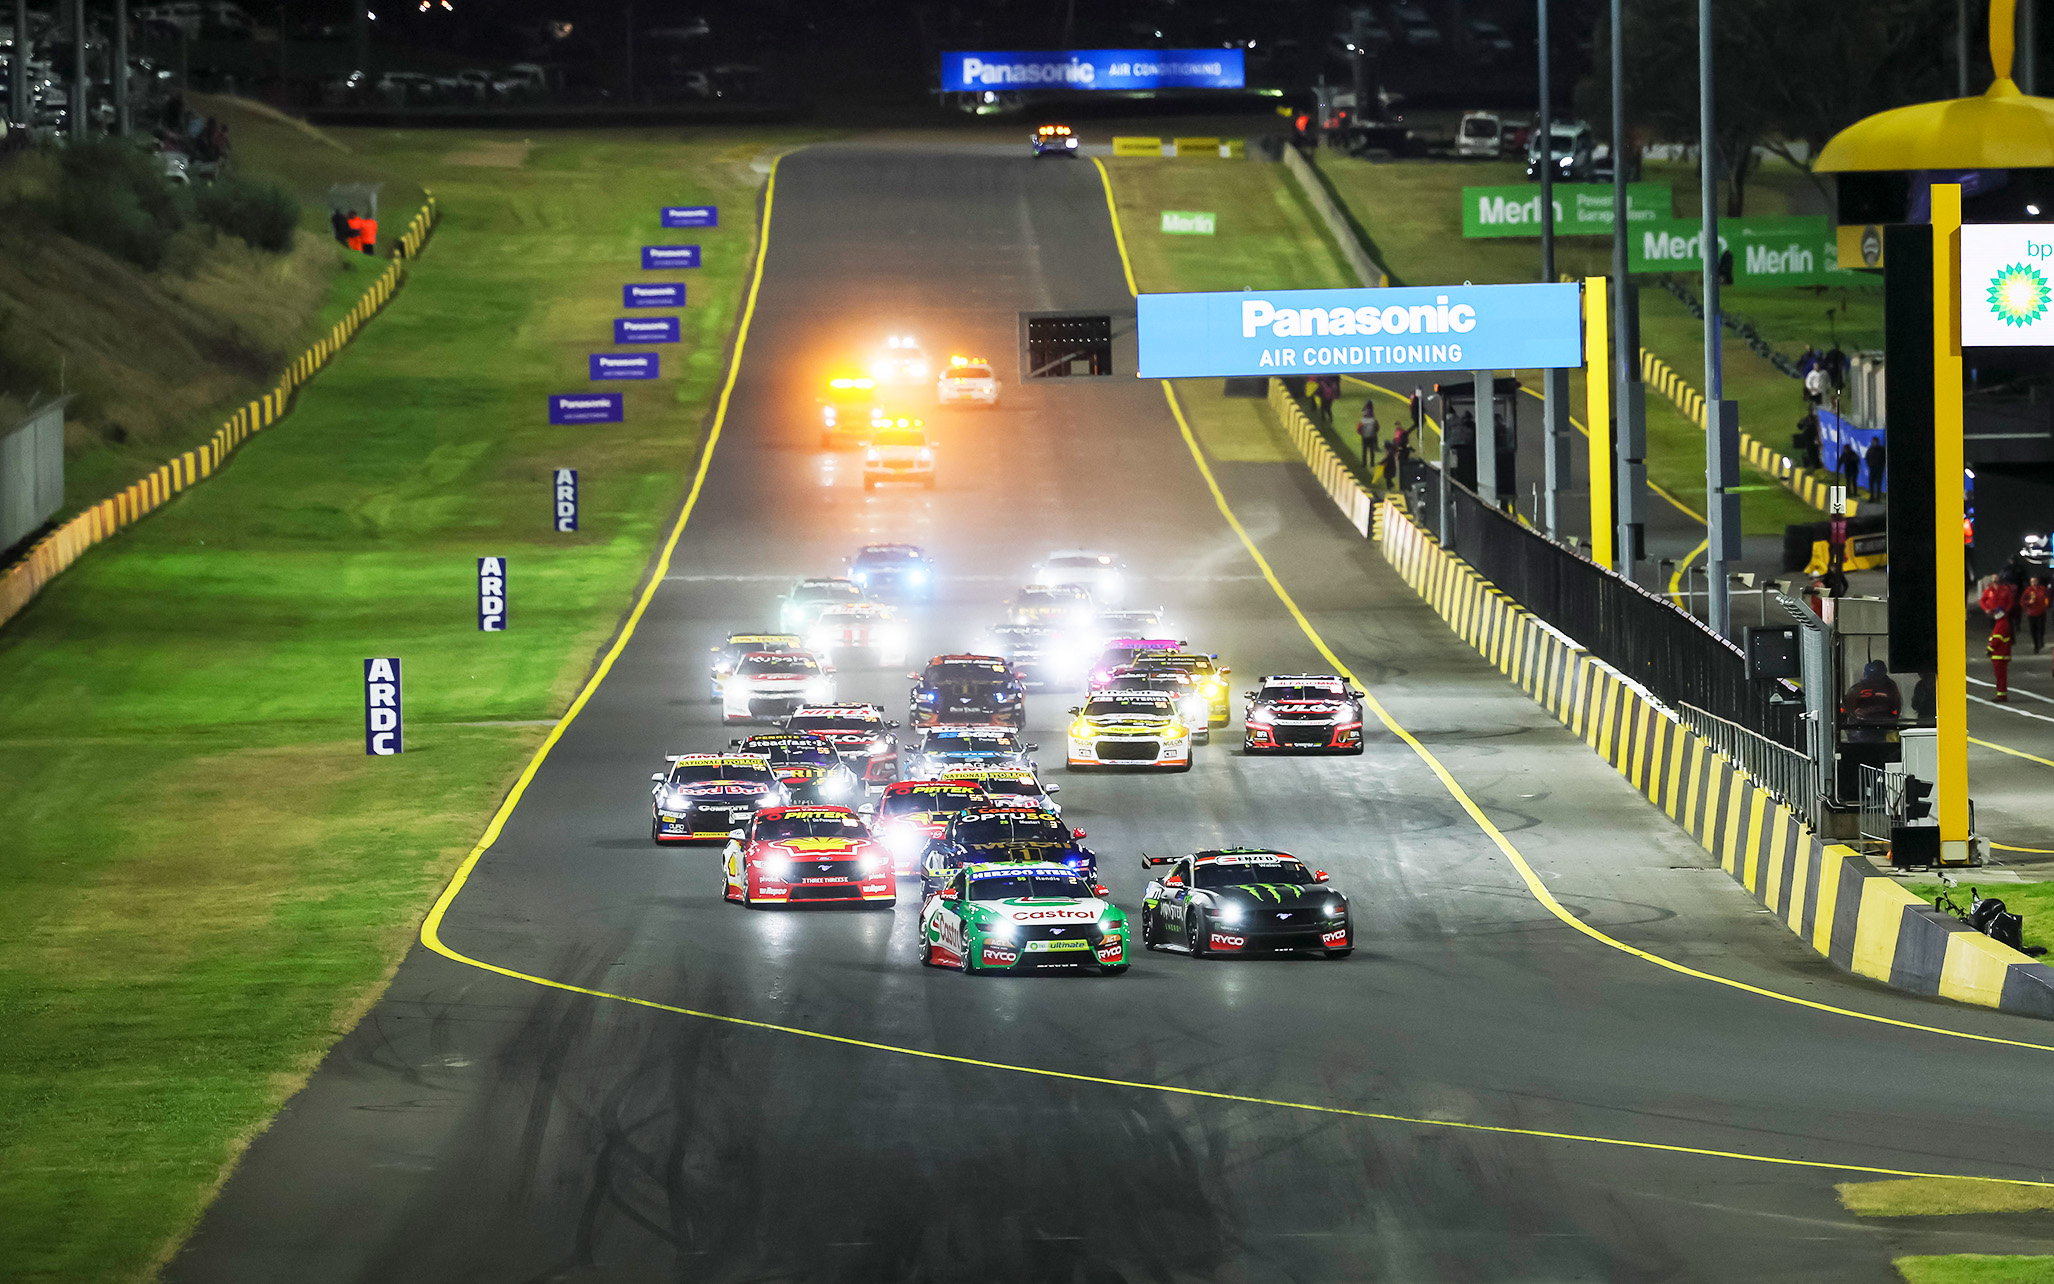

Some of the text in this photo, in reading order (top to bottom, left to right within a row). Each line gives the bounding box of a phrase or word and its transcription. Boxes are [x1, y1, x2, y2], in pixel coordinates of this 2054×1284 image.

[963, 57, 1095, 85] Panasonic
[1109, 63, 1131, 77] AIR
[1479, 196, 1563, 224] Merln
[1163, 214, 1214, 234] Merlin
[2028, 240, 2053, 261] bp
[1746, 243, 1814, 274] Merlin
[1242, 295, 1477, 338] Panasonic
[1259, 343, 1463, 368] AIR CONDITIONING
[559, 398, 612, 409] Panasonic
[557, 468, 575, 532] ARDC
[480, 557, 504, 631] ARDC
[368, 658, 397, 756] ARDC
[1264, 704, 1347, 712] NULON
[678, 785, 770, 796] Red Bull
[912, 786, 975, 794] PIRTEK
[784, 811, 848, 820] PIRTEK
[1019, 848, 1032, 861] 1
[972, 869, 1076, 880] HERZOG STEEL
[1068, 876, 1078, 885] 2
[1013, 909, 1095, 921] Castrol
[1160, 901, 1184, 922] MONSTER
[1211, 933, 1245, 946] RYCO
[1322, 929, 1346, 942] RYCO
[1050, 941, 1086, 949] ultimate
[983, 949, 1017, 962] RYCO
[1097, 946, 1122, 959] RYCO
